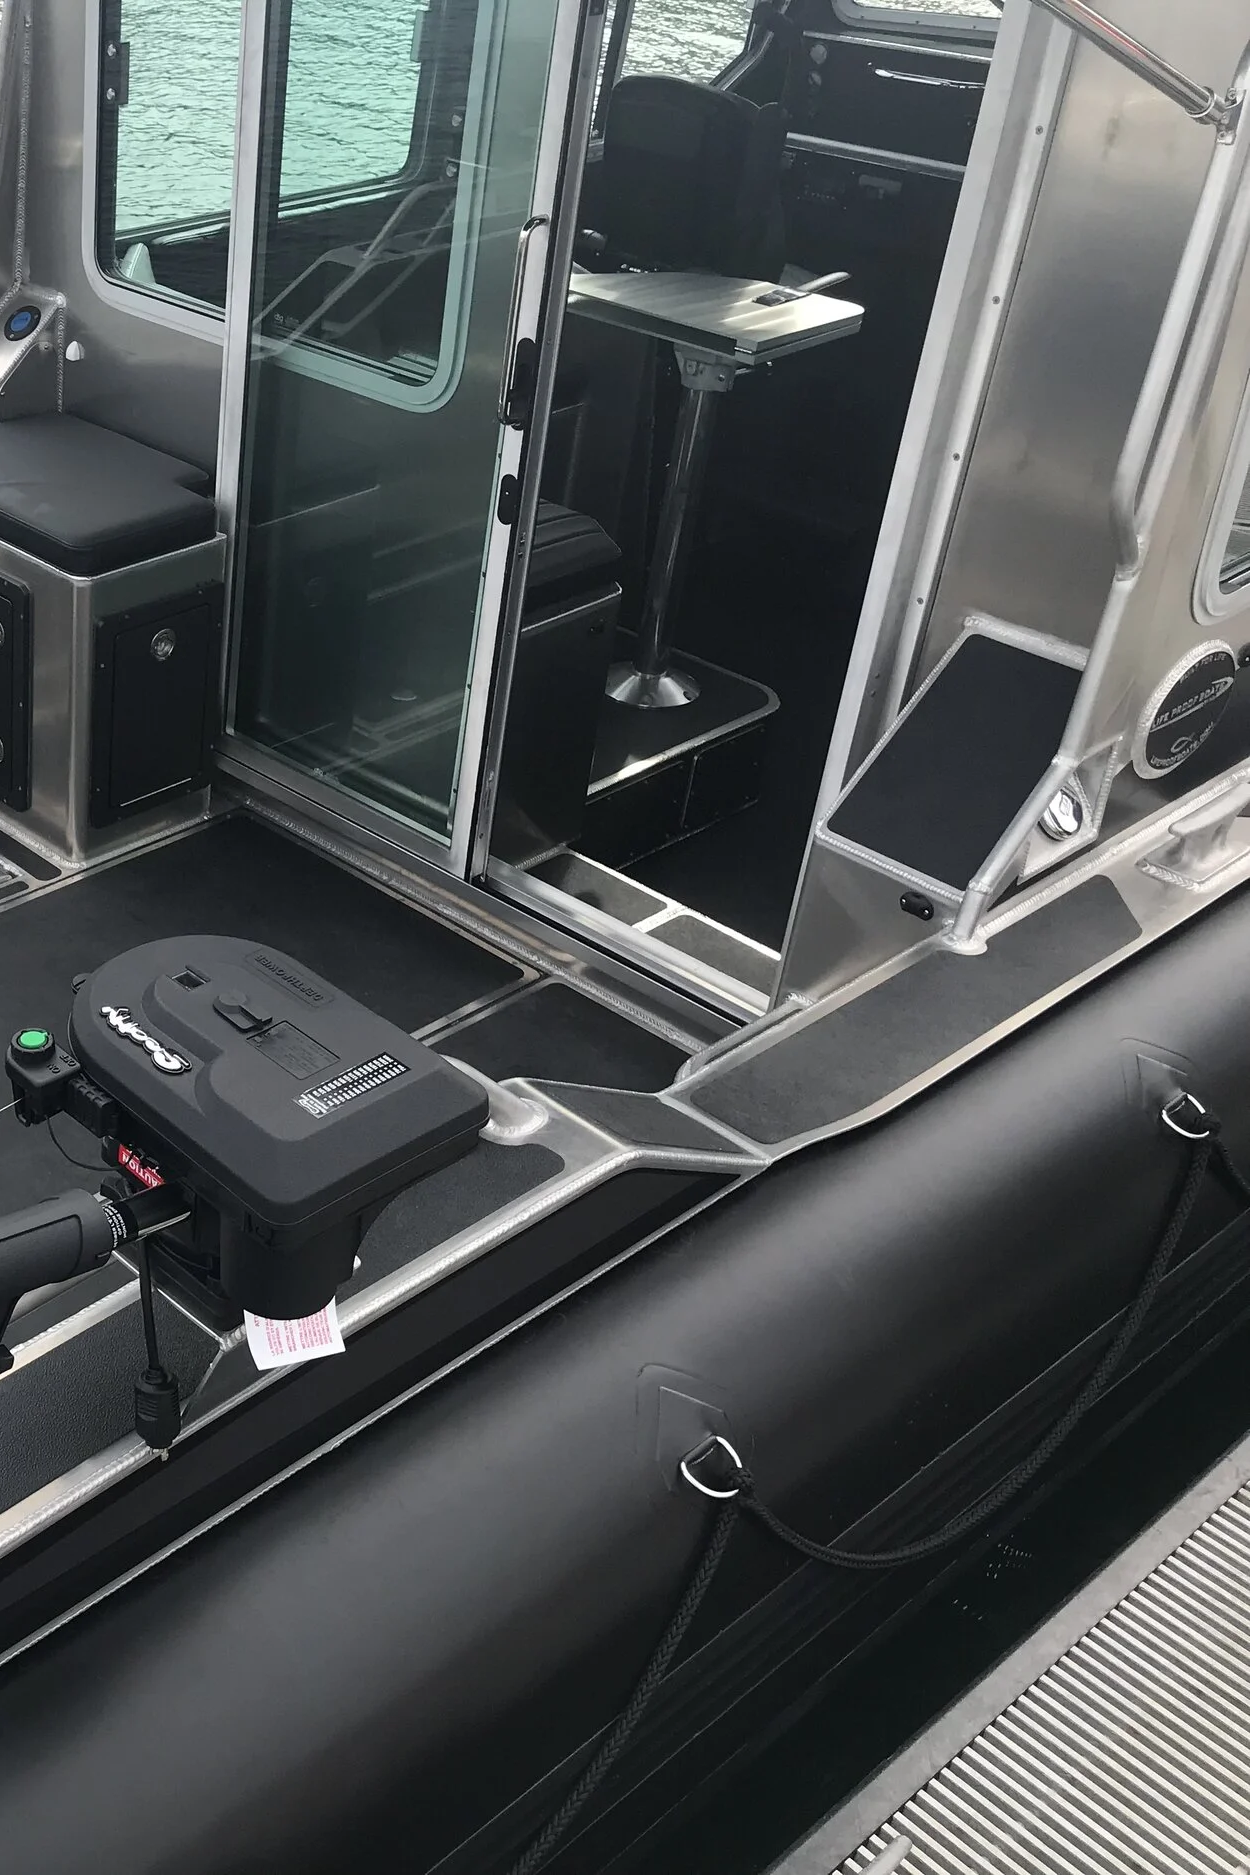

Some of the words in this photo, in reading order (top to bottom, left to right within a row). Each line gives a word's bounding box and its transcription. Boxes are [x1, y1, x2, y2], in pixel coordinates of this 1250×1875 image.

[1151, 711, 1170, 729] LIFE
[1170, 695, 1199, 718] PROOF
[253, 954, 325, 1002] DEPTHPOWER
[100, 1005, 191, 1073] Scotty
[122, 1153, 160, 1187] AUTION
